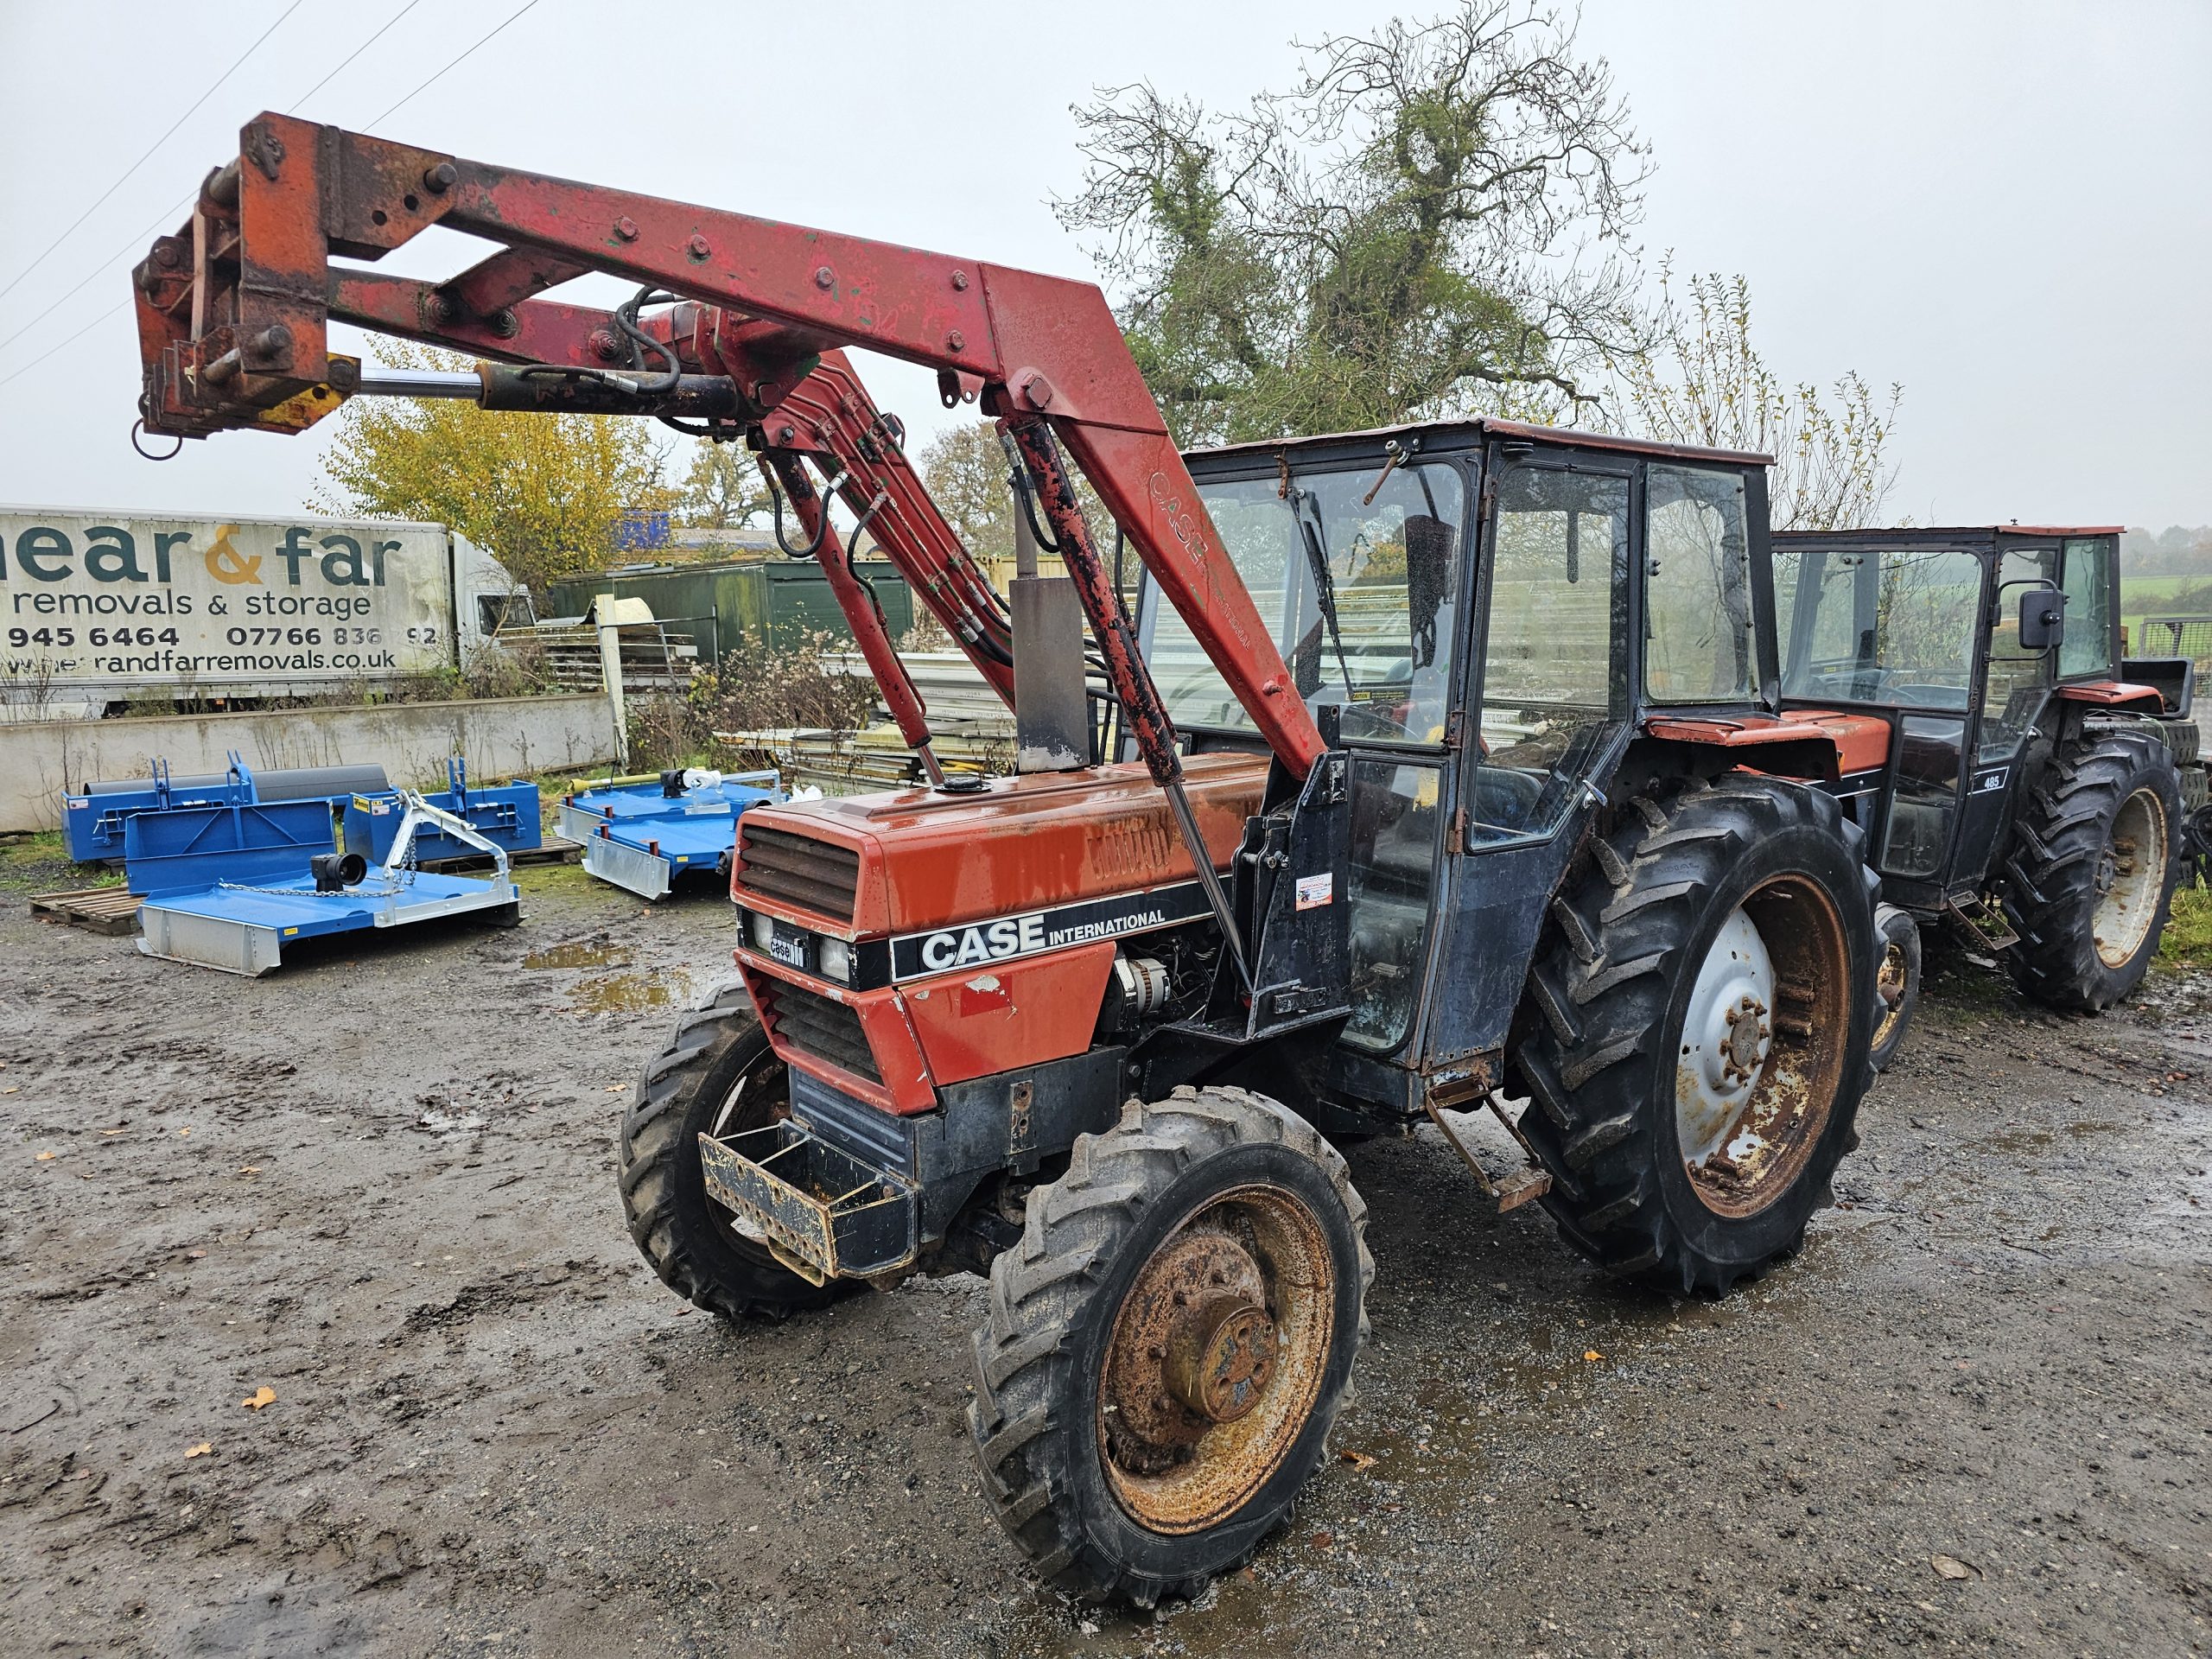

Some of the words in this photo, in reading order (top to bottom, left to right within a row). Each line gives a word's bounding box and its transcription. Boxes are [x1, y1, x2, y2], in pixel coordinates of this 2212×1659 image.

[1150, 472, 1208, 566] CASE
[205, 524, 263, 585] &
[276, 527, 403, 587] far
[13, 589, 192, 615] removals
[207, 594, 227, 615] &
[246, 591, 371, 621] storage
[8, 627, 75, 648] 945
[89, 627, 180, 646] 6464
[226, 627, 321, 645] 07766
[334, 627, 382, 645] 836
[1984, 776, 1999, 789] 485
[922, 915, 1046, 970] CASE
[1050, 910, 1165, 946] INTERNATIONAL
